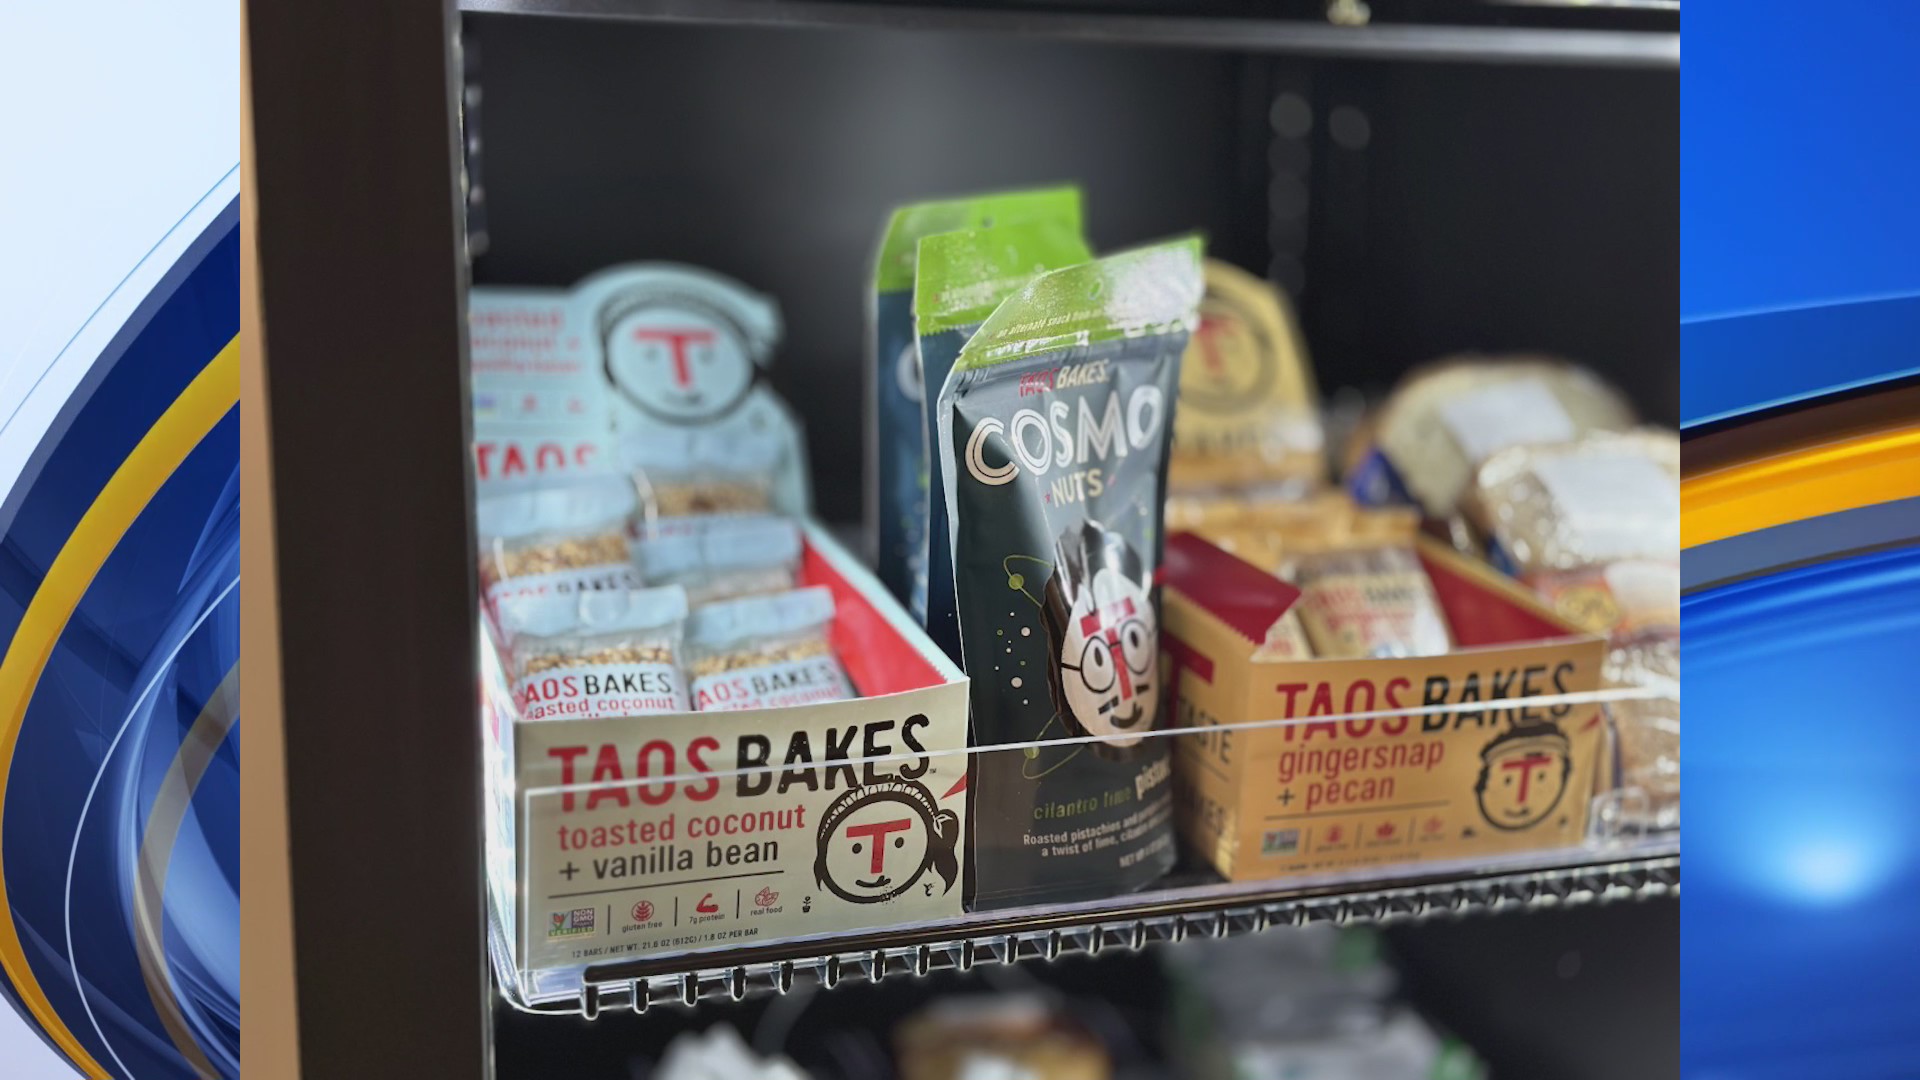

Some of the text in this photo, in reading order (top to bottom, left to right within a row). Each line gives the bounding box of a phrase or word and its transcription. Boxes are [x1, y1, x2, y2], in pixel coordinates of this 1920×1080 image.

[1056, 361, 1106, 389] BAKES
[964, 384, 1164, 486] COSMO
[1050, 468, 1104, 508] NUTS
[516, 673, 673, 704] AOS BAKES
[696, 664, 838, 711] AOS BAKES
[1276, 661, 1575, 742] TAOS BAKES
[597, 696, 675, 711] coconut
[547, 713, 930, 813] TAOS BAKES
[1278, 740, 1445, 783] gingersnap
[1033, 797, 1098, 819] cilantro
[1305, 776, 1395, 811] pecan
[558, 804, 807, 851] toasted coconut
[1023, 832, 1068, 845] Roasted
[1070, 820, 1121, 842] pistachios
[593, 844, 693, 879] vanilla
[706, 840, 779, 868] bean
[1041, 847, 1049, 857] a
[1052, 843, 1080, 856] twist
[1082, 839, 1094, 853] of
[689, 913, 726, 925] 7g protein
[750, 906, 783, 916] real food
[584, 949, 602, 957] BARS
[610, 946, 624, 954] NET
[626, 944, 640, 952] WT.
[661, 939, 670, 947] OZ
[704, 933, 715, 941] 1.8
[718, 931, 727, 939] OZ
[728, 929, 742, 937] PER
[744, 927, 758, 936] BAR
[621, 921, 663, 933] gluten free
